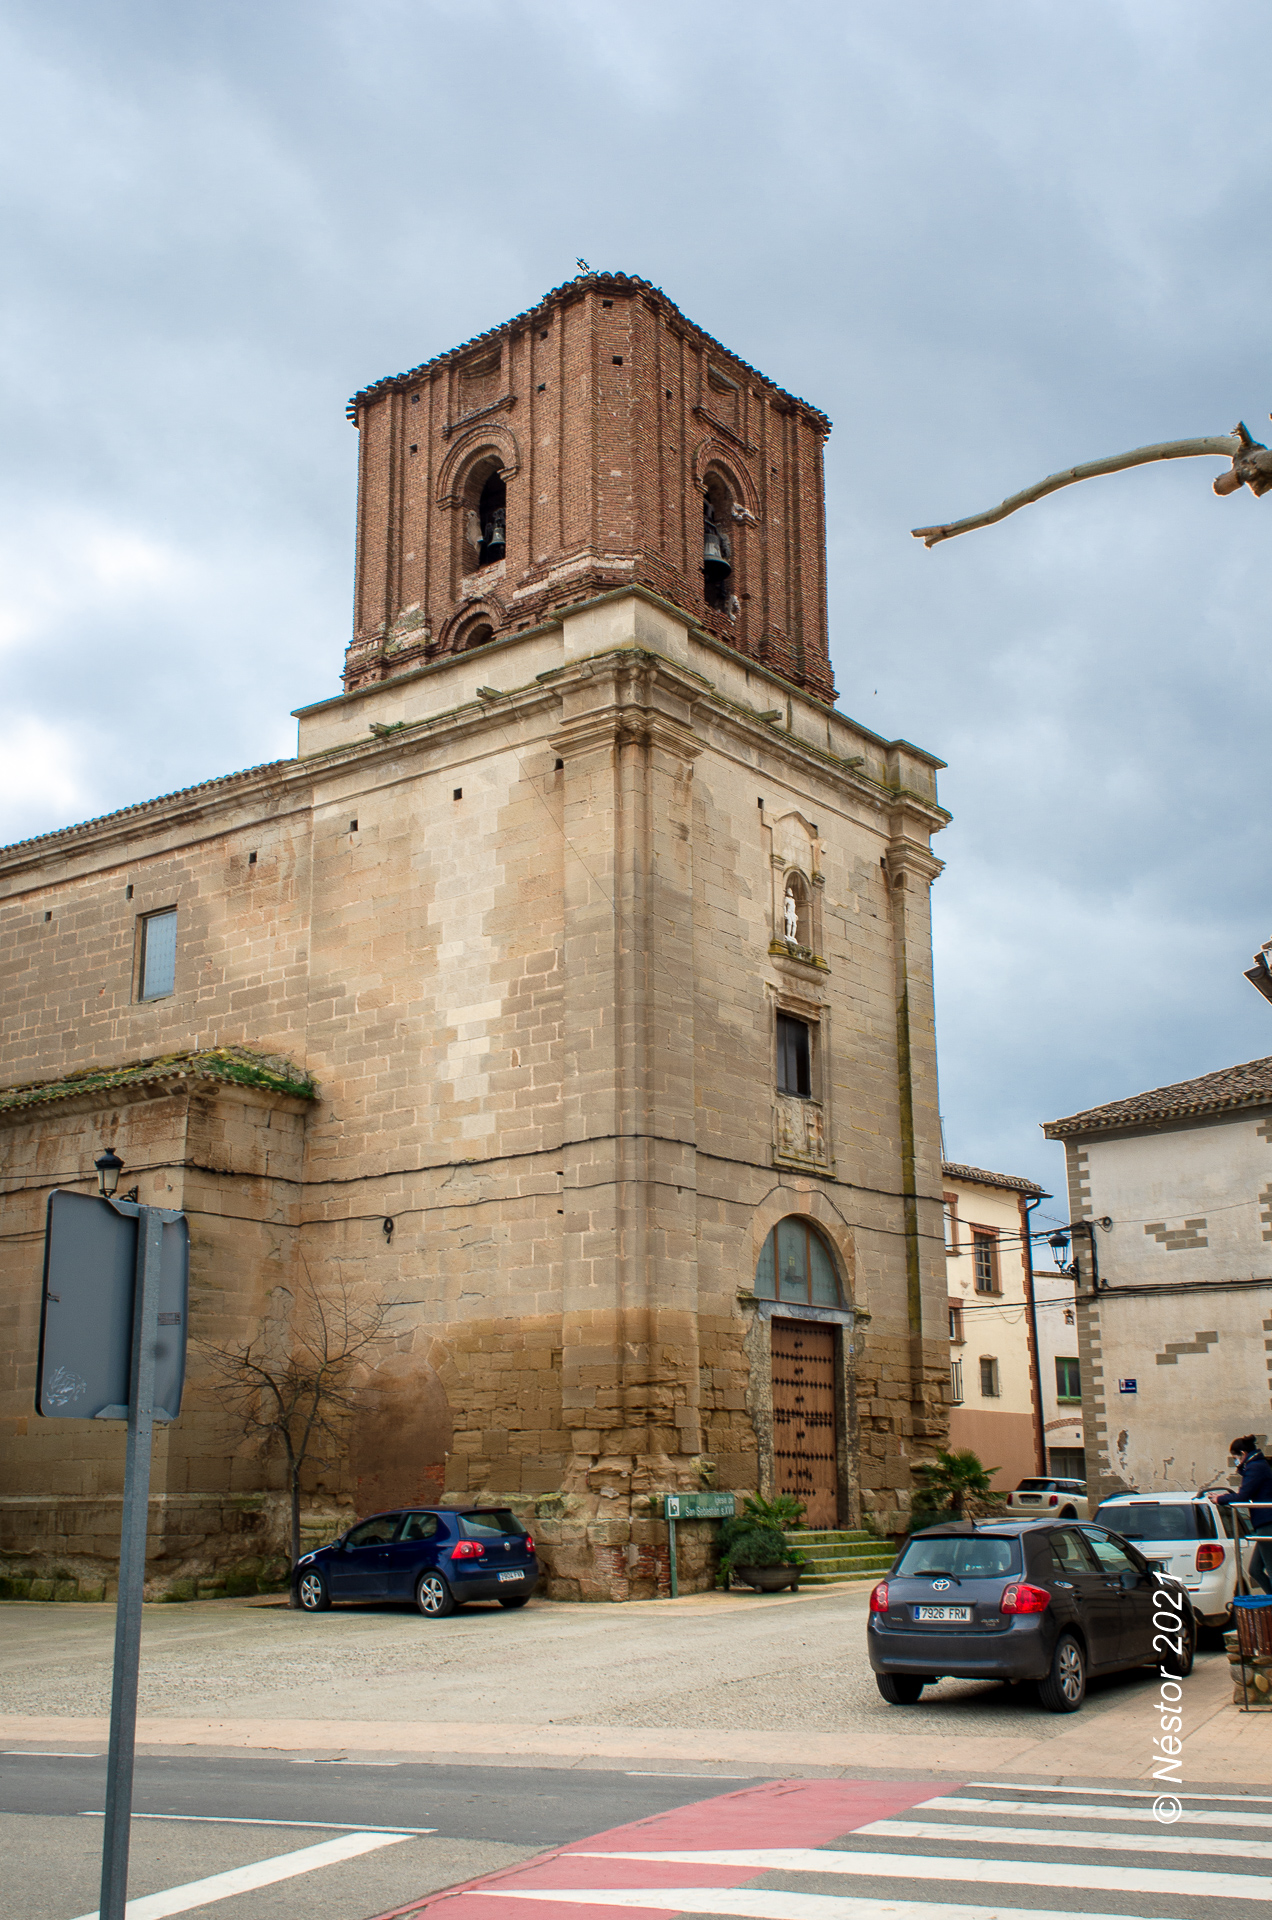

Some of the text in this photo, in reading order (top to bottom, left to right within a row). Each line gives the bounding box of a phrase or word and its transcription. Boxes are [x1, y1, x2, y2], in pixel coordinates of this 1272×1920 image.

[685, 1506, 696, 1517] San
[921, 1607, 967, 1620] 7926 FRM
